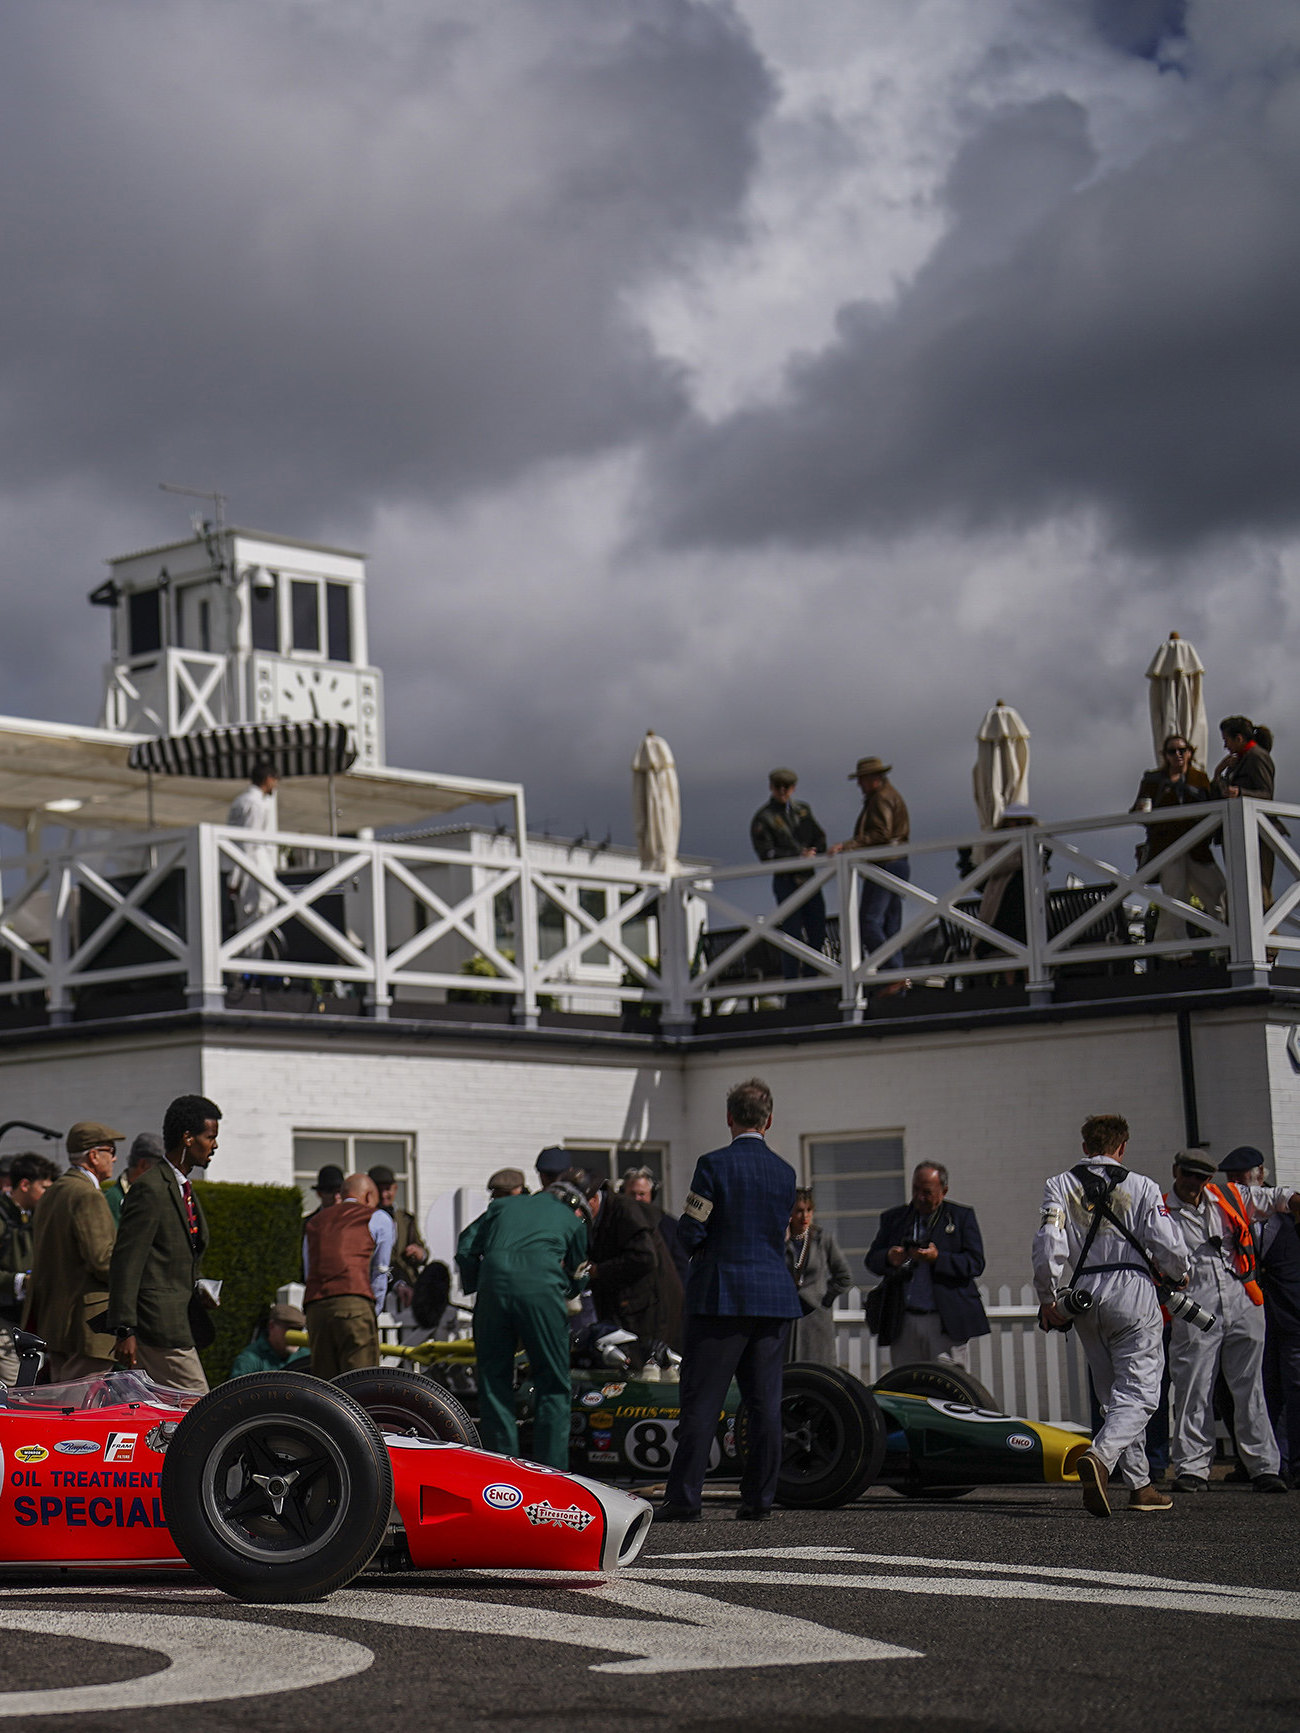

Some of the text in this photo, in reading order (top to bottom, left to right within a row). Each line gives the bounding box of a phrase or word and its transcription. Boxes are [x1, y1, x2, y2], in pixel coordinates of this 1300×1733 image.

[615, 1405, 659, 1418] LOTUS
[1011, 1436, 1030, 1447] ENCO
[10, 1470, 42, 1487] OIL
[488, 1489, 516, 1502] ENCO
[14, 1495, 169, 1528] SPECIAL
[540, 1509, 579, 1521] Firestone
